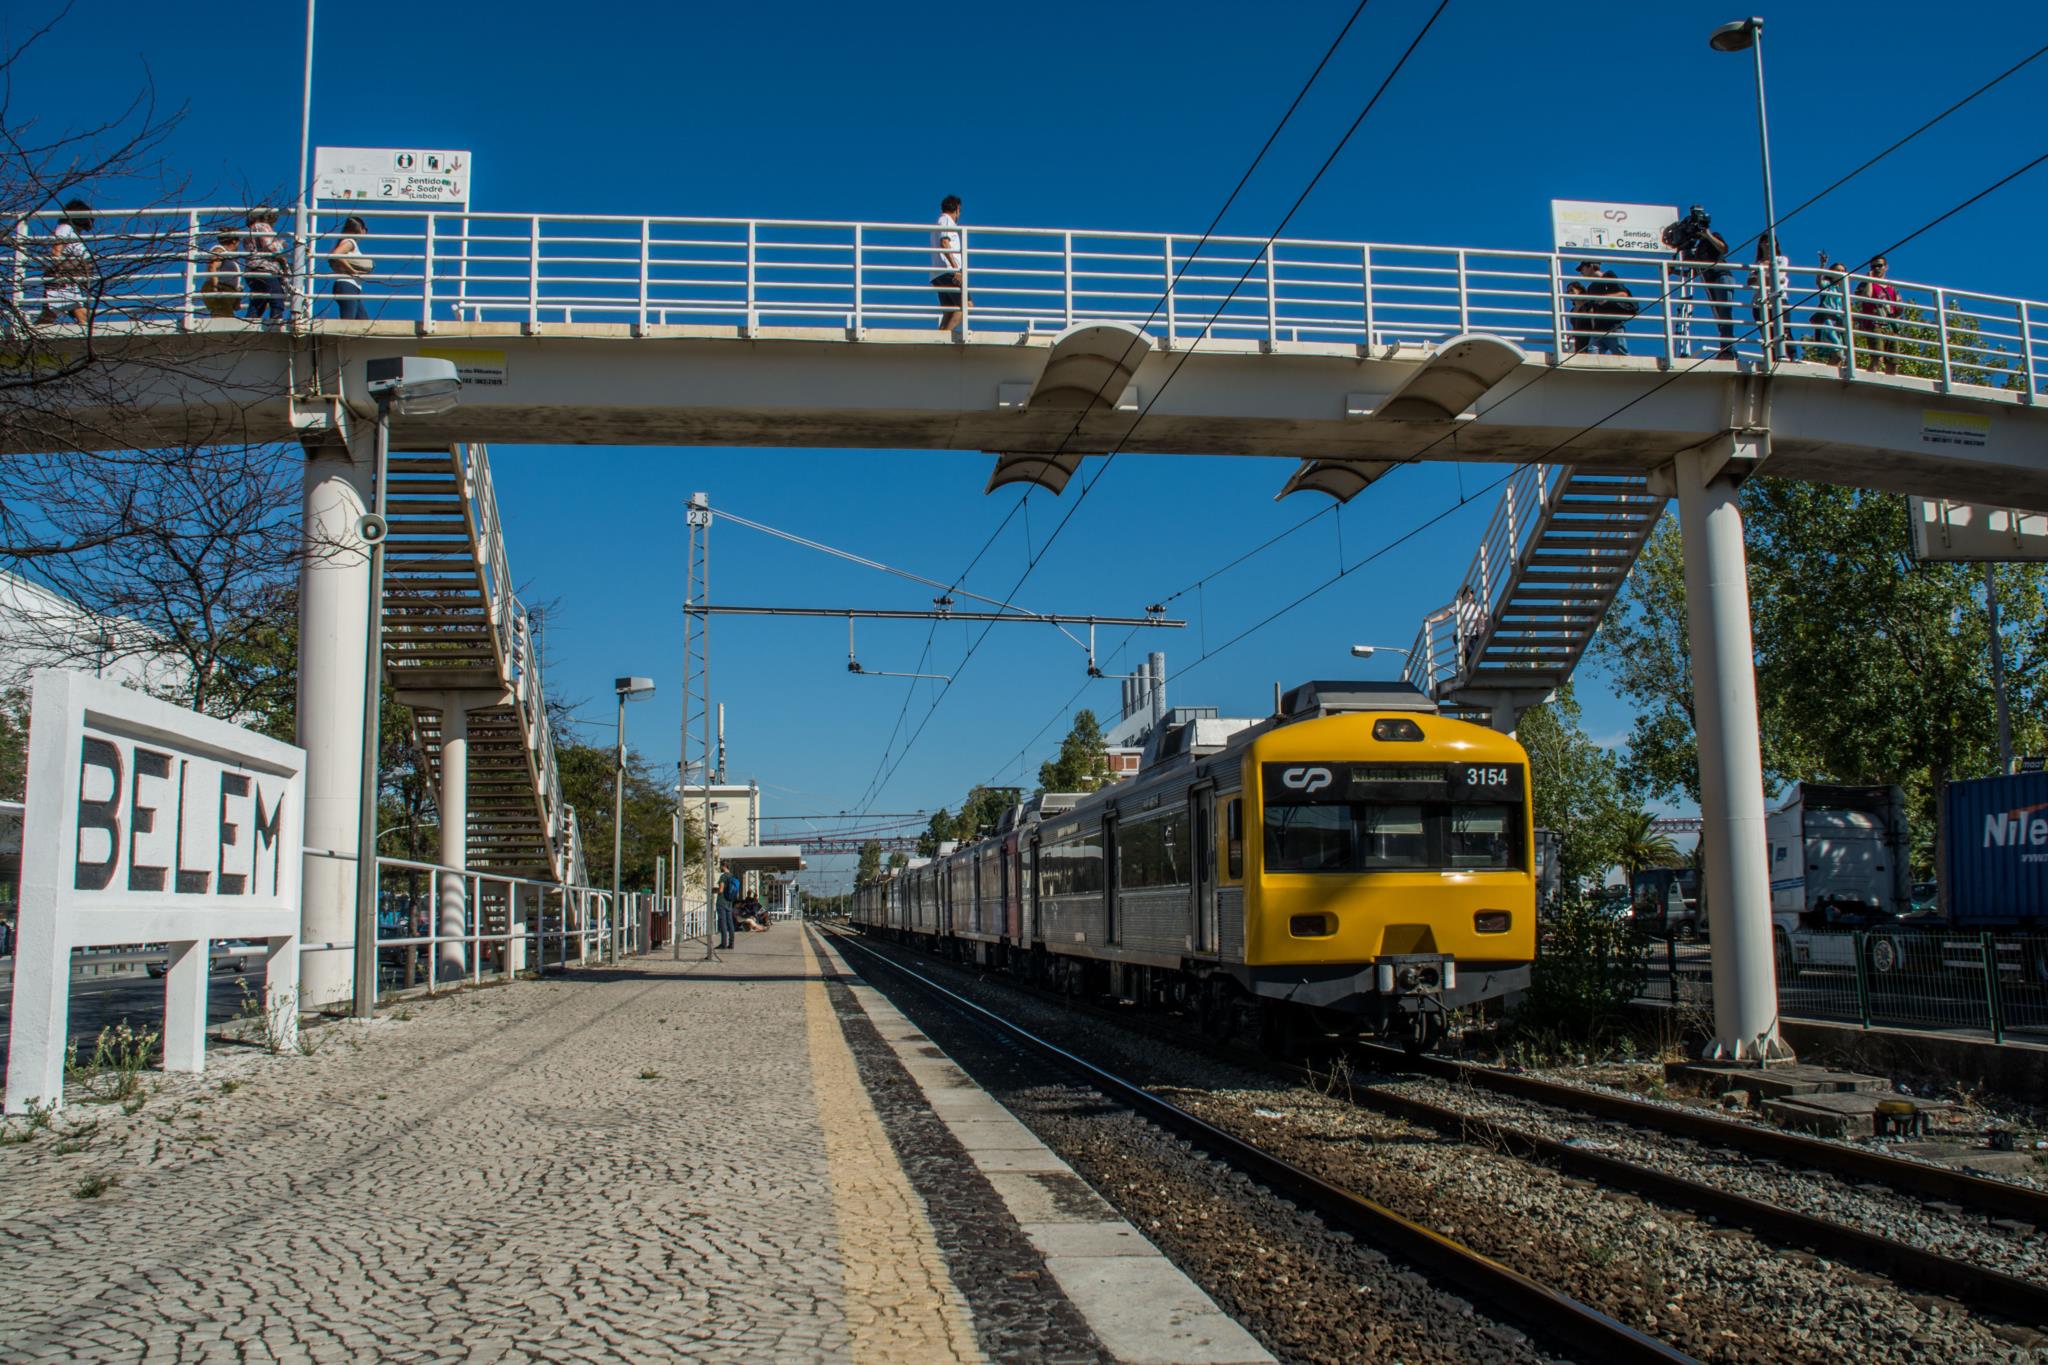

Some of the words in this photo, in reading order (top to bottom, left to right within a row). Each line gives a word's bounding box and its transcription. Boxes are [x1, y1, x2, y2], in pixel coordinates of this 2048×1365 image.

[408, 176, 442, 185] Sentido
[383, 184, 393, 196] 2
[409, 192, 440, 200] (Lisboa)
[1596, 234, 1603, 245] 1
[1623, 230, 1651, 238] Sentido
[1283, 767, 1333, 793] CP
[1467, 768, 1508, 786] 3154
